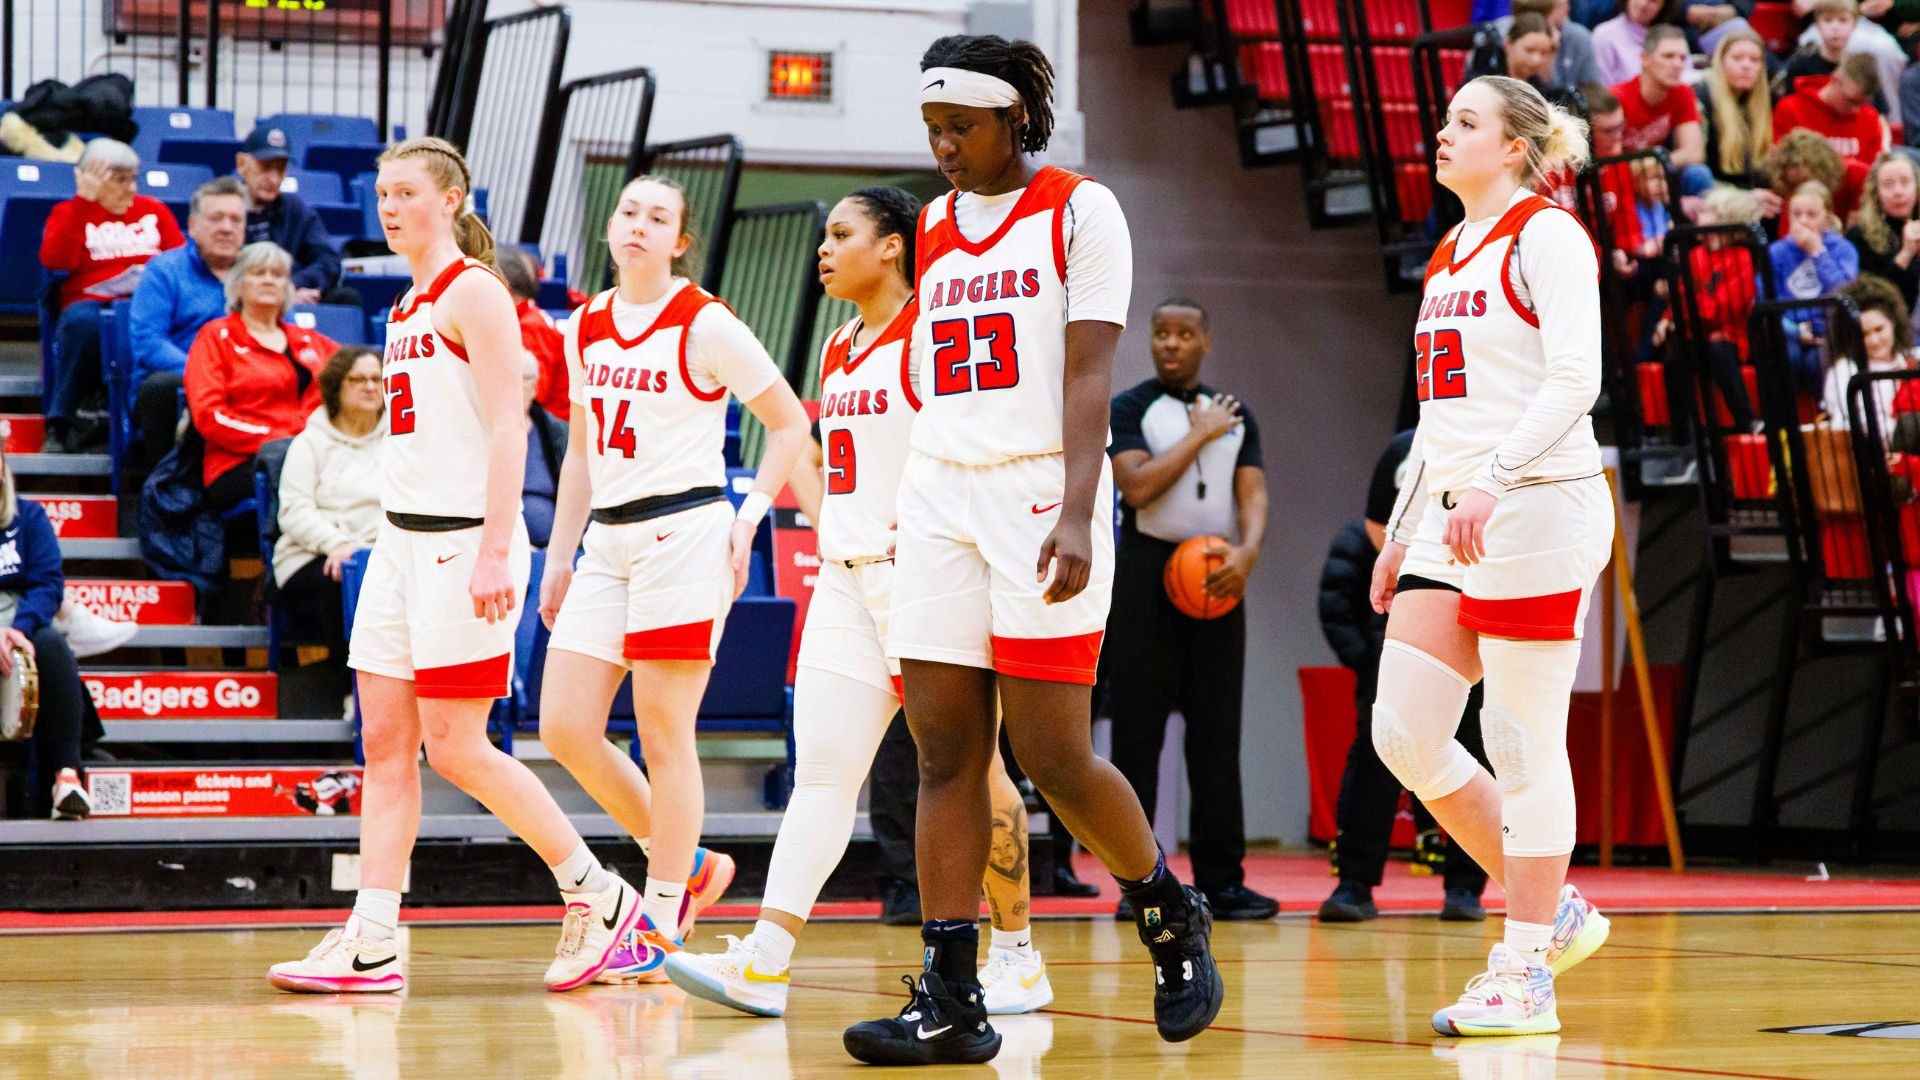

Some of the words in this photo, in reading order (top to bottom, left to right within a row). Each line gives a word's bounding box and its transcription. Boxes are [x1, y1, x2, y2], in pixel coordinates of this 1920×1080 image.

[928, 268, 1040, 311] ADGERS
[1418, 290, 1487, 322] DGERS
[385, 333, 435, 365] DGERS
[931, 312, 1020, 396] 23
[584, 363, 667, 393] ADGERS
[1415, 328, 1467, 403] 22
[821, 388, 888, 418] DGERS
[591, 397, 636, 459] 14
[828, 428, 857, 495] 9
[43, 502, 82, 521] ASS
[63, 585, 107, 604] SON
[110, 585, 160, 604] PASS
[87, 602, 141, 620] ONLY
[84, 678, 209, 715] Badgers
[213, 678, 260, 708] Go
[194, 774, 244, 788] tickets
[244, 773, 272, 788] and
[132, 791, 181, 803] season
[183, 791, 230, 805] passes
